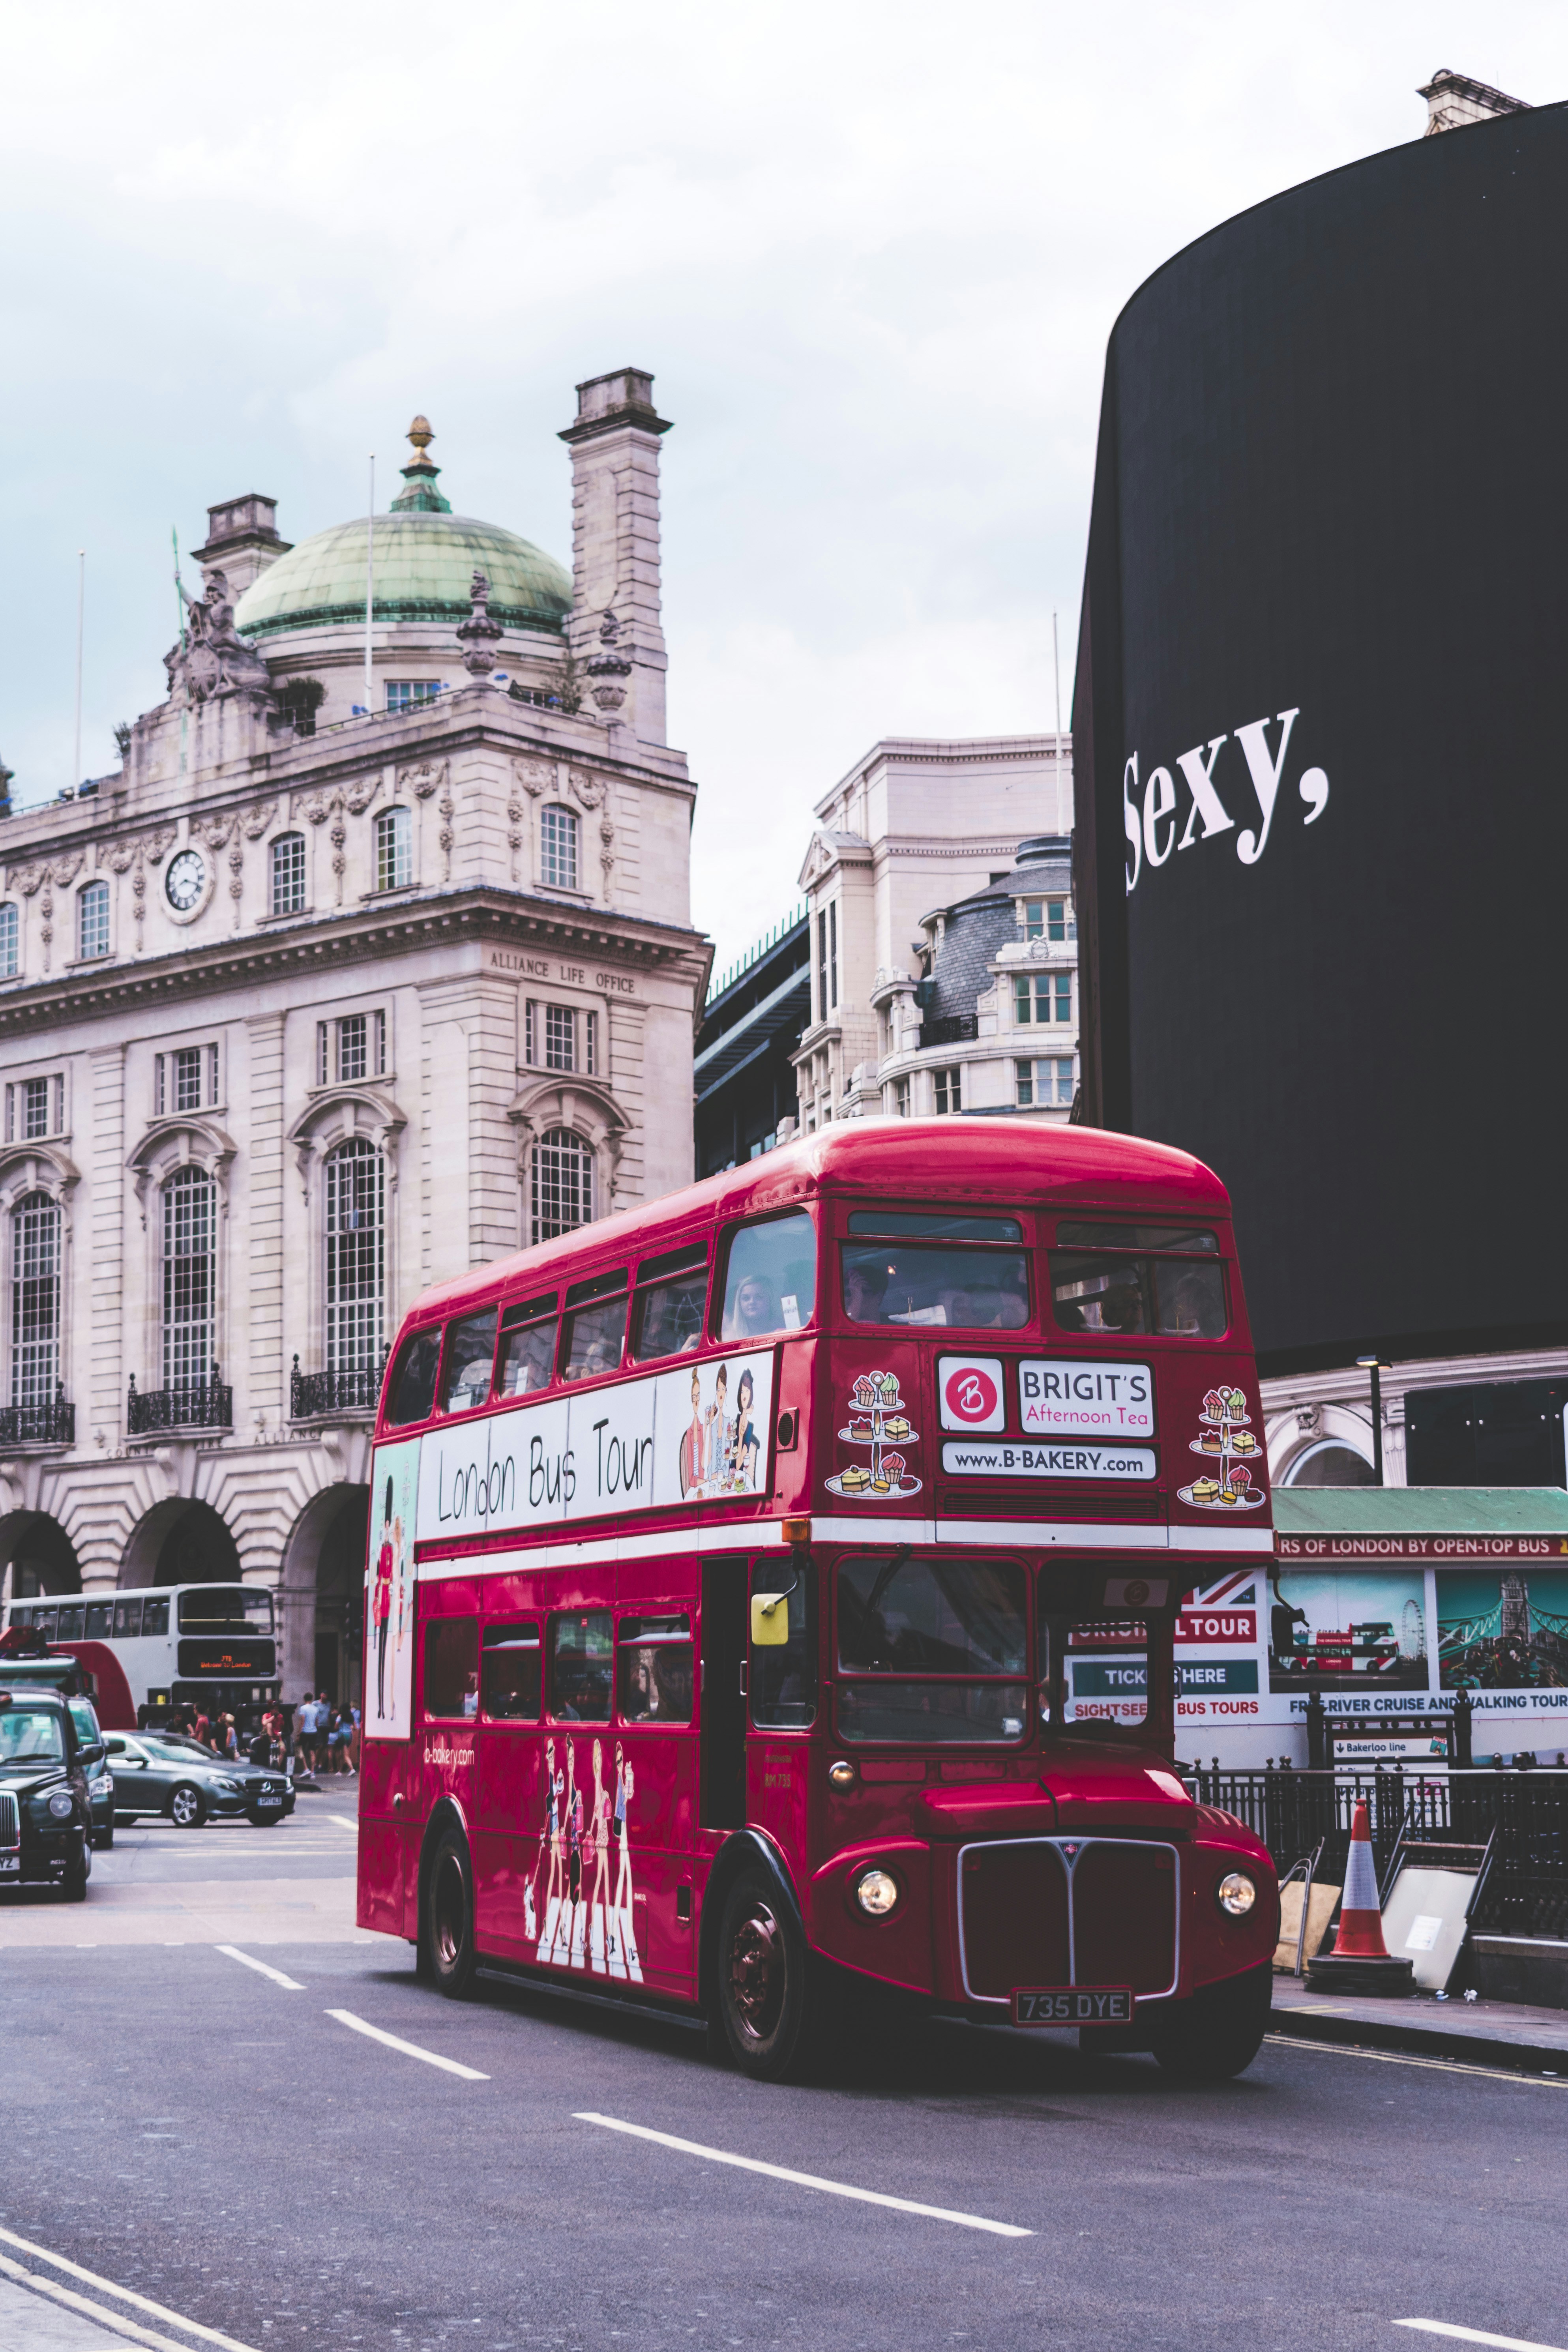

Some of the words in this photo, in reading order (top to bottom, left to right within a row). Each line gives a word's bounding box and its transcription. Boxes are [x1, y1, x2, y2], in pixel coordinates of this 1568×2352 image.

[1124, 707, 1329, 897] Sexy,
[491, 952, 549, 977] ALLIANCE
[560, 966, 585, 984] LIFE
[596, 973, 635, 993] OFFICE
[1023, 1371, 1146, 1402] BRIGIT'S
[1026, 1403, 1111, 1424] Afternoon
[1116, 1407, 1148, 1425] Tea
[438, 1449, 515, 1522] London
[530, 1435, 576, 1507] Bus
[593, 1418, 653, 1497] Tour
[954, 1449, 1143, 1472] www.B-BAKERY.com
[1305, 1539, 1326, 1553] OF
[1332, 1539, 1403, 1553] LONDON
[1408, 1539, 1429, 1553] BY
[1433, 1539, 1514, 1553] OPEN-TOP
[1518, 1539, 1550, 1553] BUS
[1190, 1618, 1250, 1636] TOUR
[1182, 1668, 1226, 1683] HERE
[1075, 1703, 1147, 1717] SIGHTSEE
[1176, 1702, 1206, 1715] BUS
[1210, 1701, 1259, 1714] TOURS
[1290, 1700, 1324, 1713] FR
[1328, 1698, 1371, 1712] RIVER
[1373, 1697, 1425, 1711] CRUISE
[1428, 1697, 1459, 1710] AND
[425, 1735, 474, 1773] b-bakery.com
[1346, 1742, 1386, 1752] Bakerloo
[1389, 1742, 1407, 1751] line
[765, 1773, 776, 1788] RM
[777, 1773, 791, 1788] 735
[1023, 1995, 1070, 2019] 735
[1077, 1994, 1124, 2017] DYE
